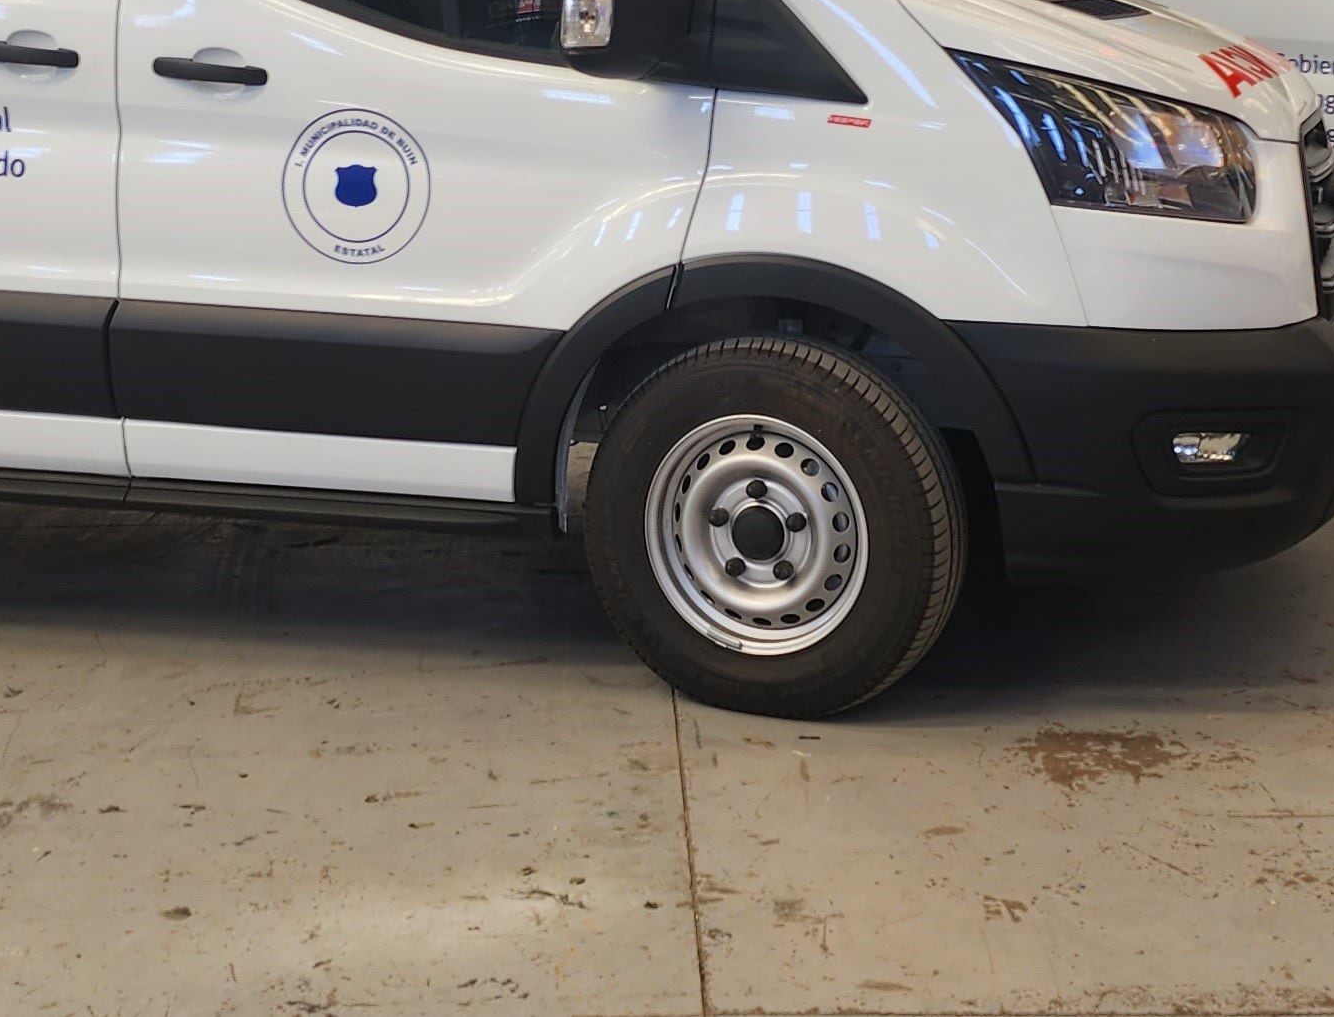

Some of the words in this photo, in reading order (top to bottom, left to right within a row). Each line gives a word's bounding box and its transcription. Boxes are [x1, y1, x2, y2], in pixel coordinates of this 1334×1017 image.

[300, 118, 379, 158] MUNICIPALIDAD
[396, 138, 419, 166] BUIN
[334, 244, 386, 258] ESTATAL
